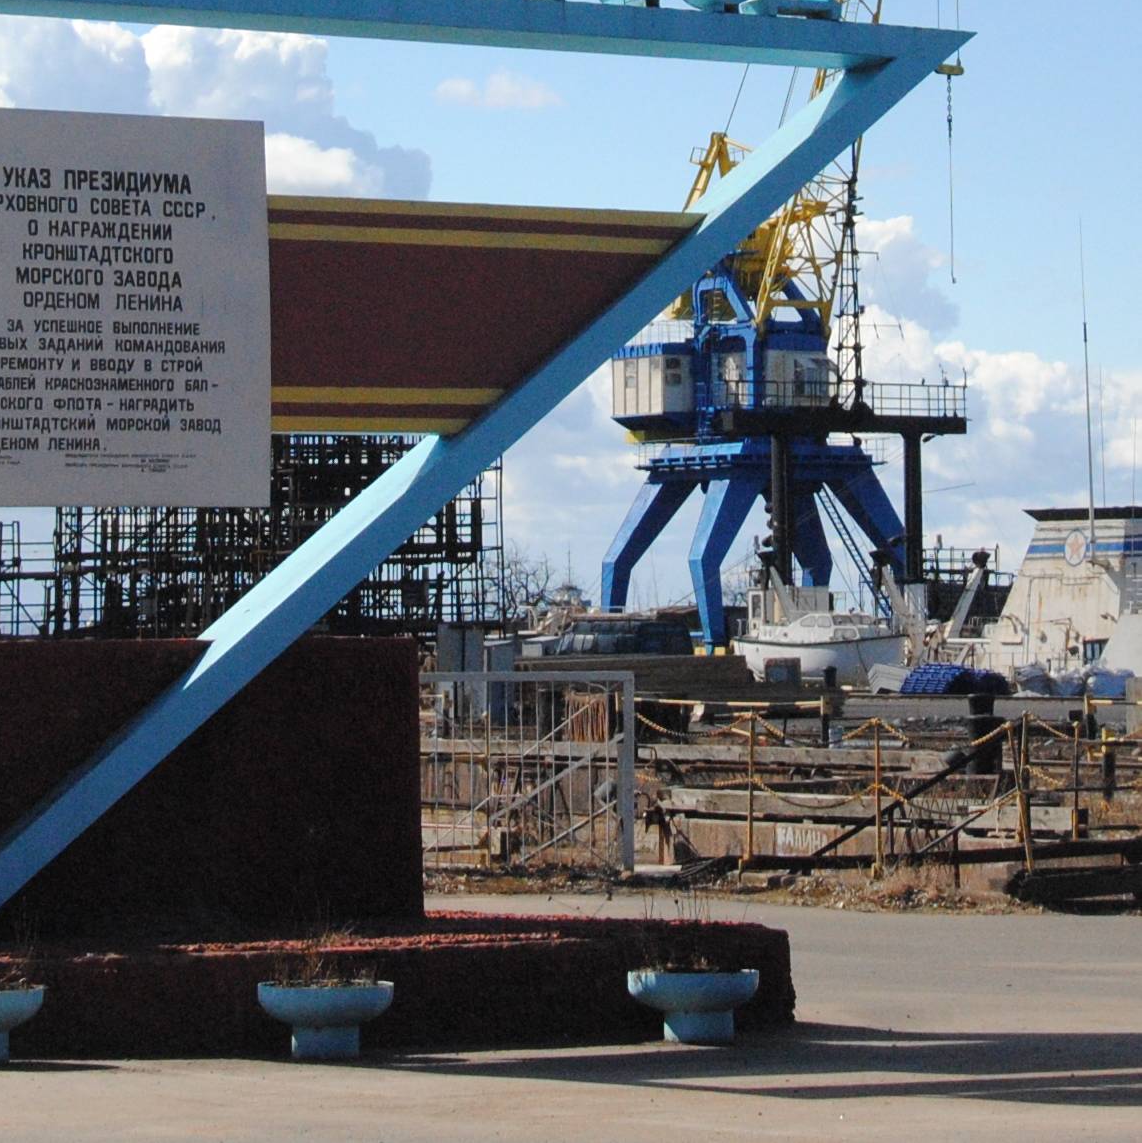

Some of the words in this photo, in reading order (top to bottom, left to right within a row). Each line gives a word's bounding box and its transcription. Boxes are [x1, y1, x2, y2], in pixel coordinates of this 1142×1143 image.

[3, 166, 51, 189] УКАЗ
[63, 169, 192, 196] ПРЕЗИДИУМА
[90, 197, 151, 217] СОВЕТА
[27, 219, 38, 236] О
[48, 220, 172, 242] НАГРАЖДЕНИИ
[22, 243, 174, 266] КРОНШТАДТСКОГО
[16, 266, 103, 286] МОРСКОГО
[113, 270, 182, 292] ЗАВОДА
[23, 291, 100, 311] ОРДЕНОМ
[116, 293, 183, 312] ЛЕНИНА
[7, 319, 24, 332] ЗА
[34, 319, 102, 334] УСПЕШНОЕ
[113, 321, 200, 336] ВЫПОЛНЕНИЕ
[38, 336, 103, 355] ЗАДАНИЙ
[115, 339, 225, 356] КОМАНДОВАНИЯ
[0, 357, 64, 370] РЕМОНТУ
[71, 358, 80, 371] И
[90, 358, 135, 374] ВВОДУ
[144, 359, 152, 372] В
[161, 356, 203, 372] СТРОЙ
[45, 377, 174, 392] КРАСНОЗНАМЕННОГО
[53, 397, 101, 411] ФЛОТА
[119, 398, 194, 414] НАГРАДИТЬ
[106, 413, 170, 432] МОРСКОЙ
[180, 418, 221, 434] ЗАВОД
